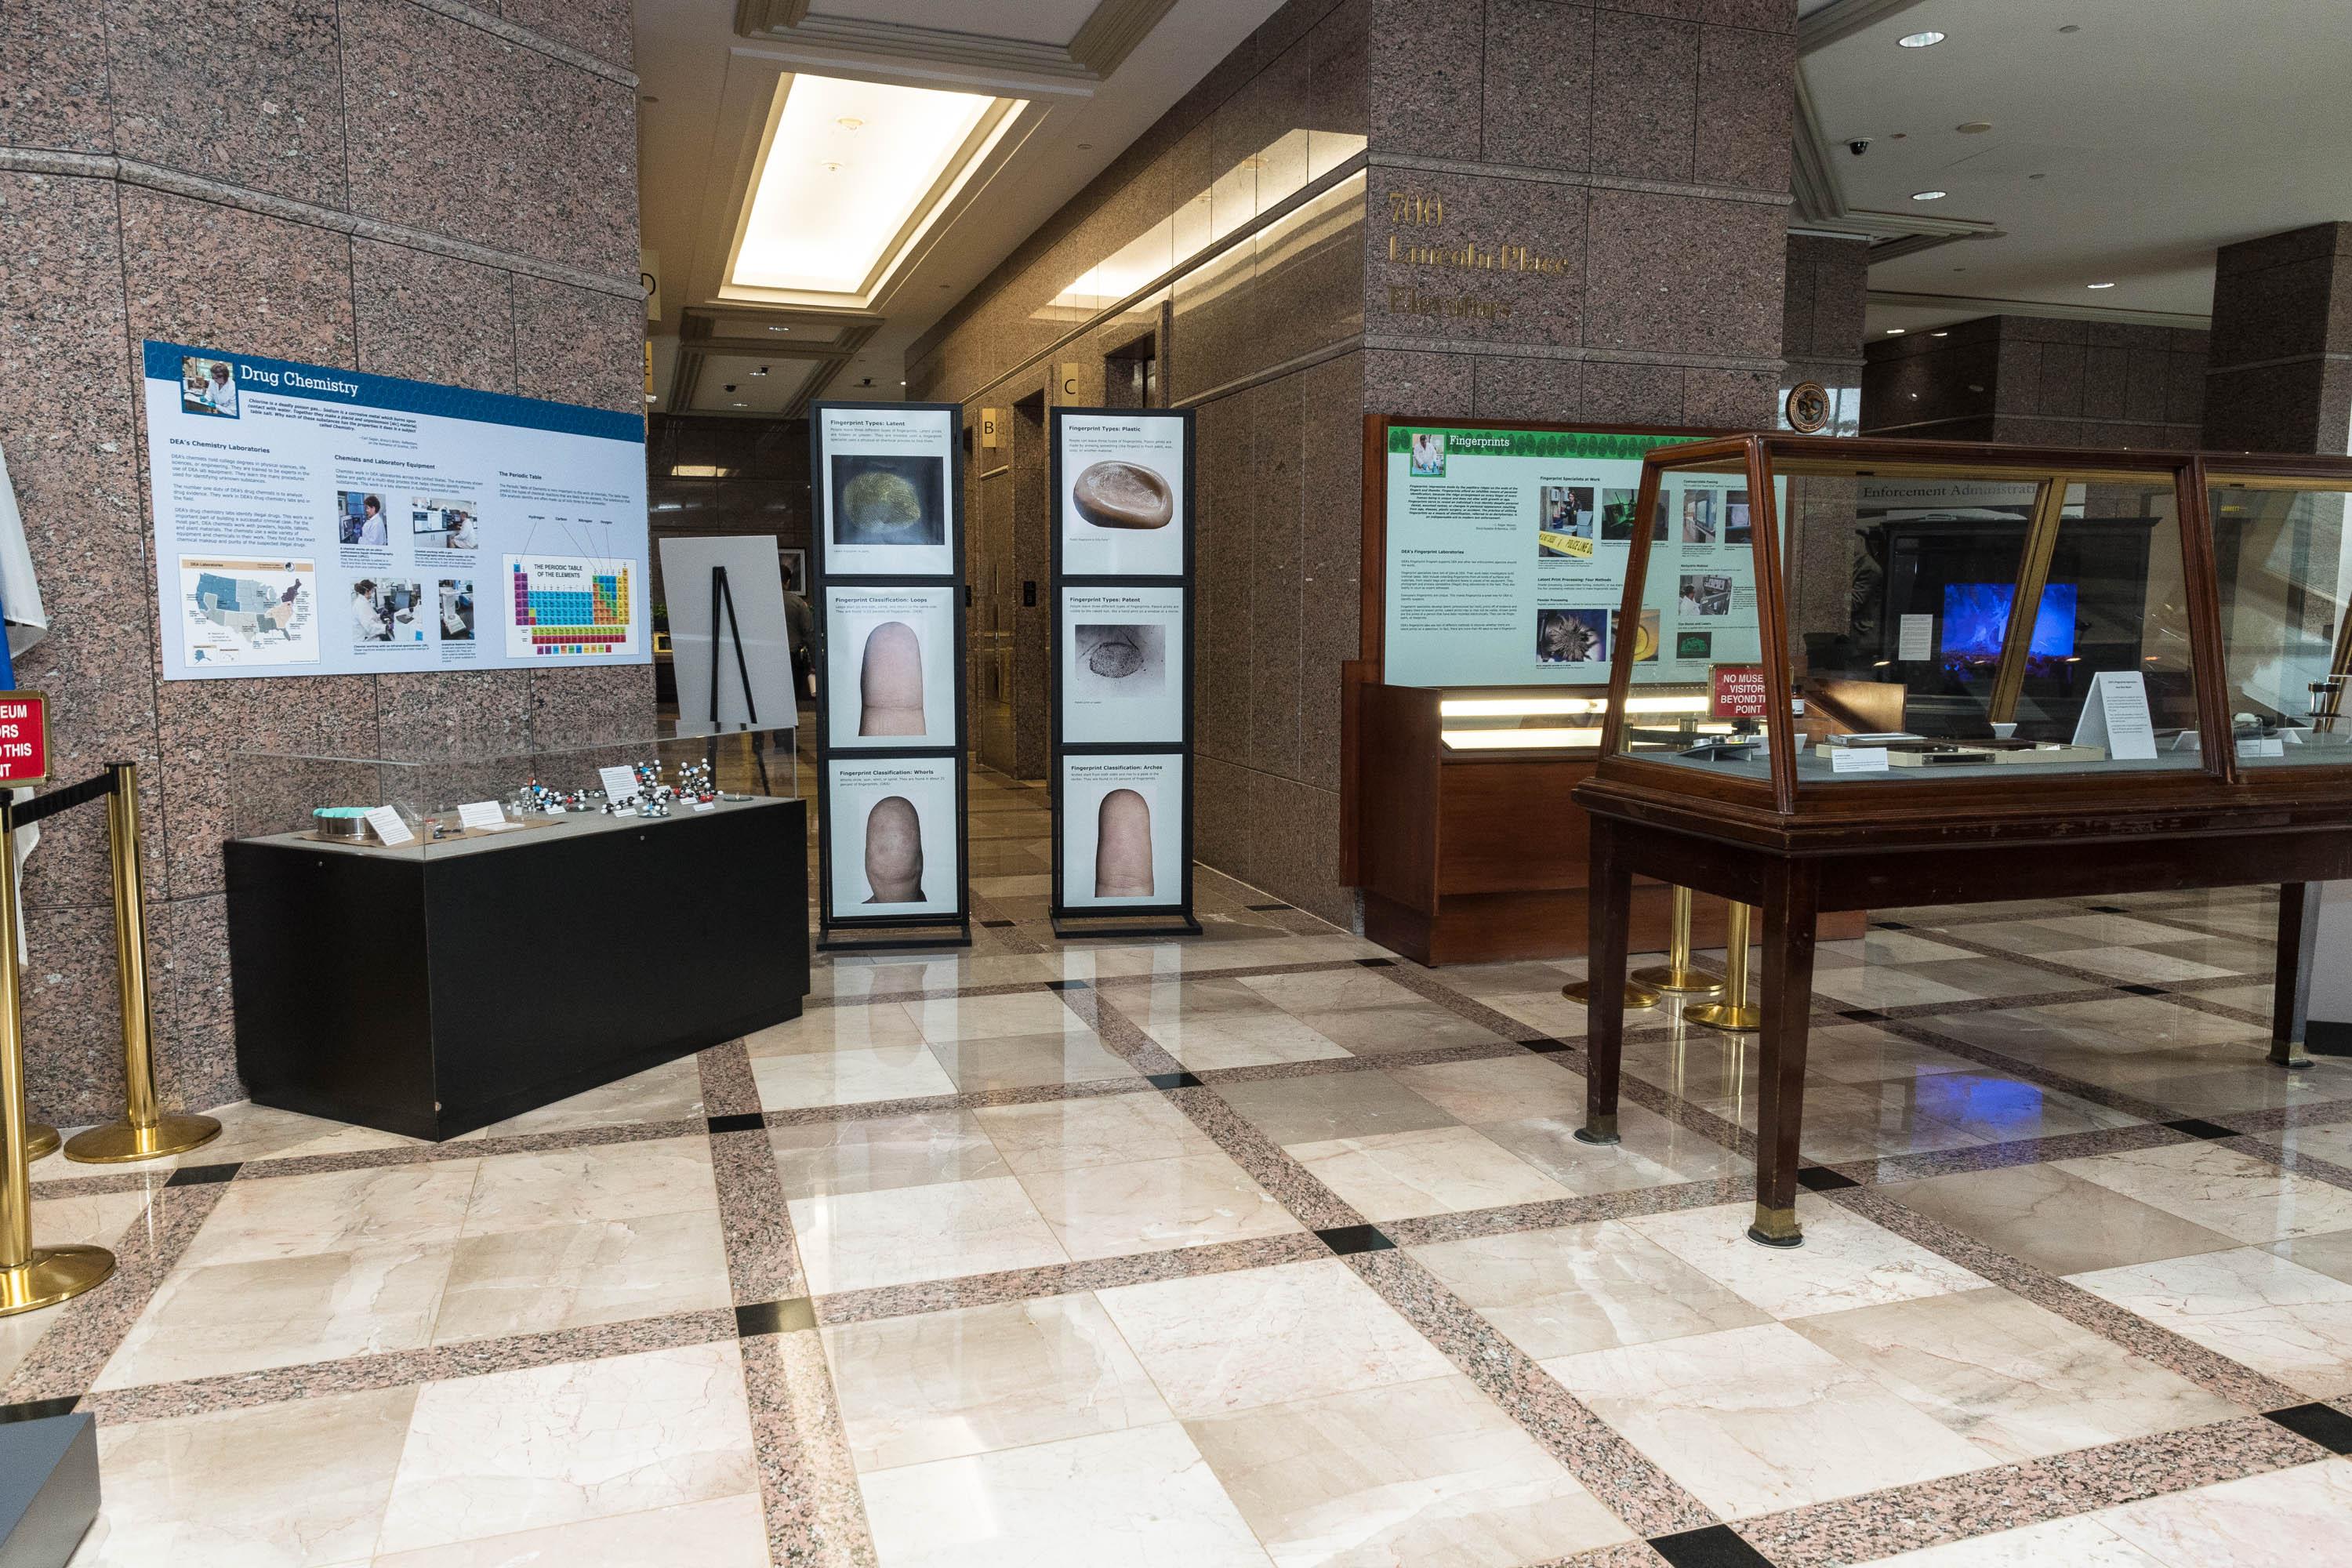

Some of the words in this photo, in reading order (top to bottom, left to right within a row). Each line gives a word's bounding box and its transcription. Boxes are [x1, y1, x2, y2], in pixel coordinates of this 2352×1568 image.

[1389, 192, 1443, 227] 700
[1390, 235, 1493, 270] Lincoln
[1388, 284, 1512, 318] Elevators
[240, 364, 279, 384] Drug
[285, 371, 358, 397] Chemistry
[1064, 379, 1076, 394] C
[985, 421, 993, 434] B
[191, 440, 227, 450] Chemistry
[228, 444, 269, 453] Laboratories
[1450, 435, 1510, 448] Fingerprints
[374, 459, 405, 467] Laboratory
[1863, 485, 1948, 497] Enforcement
[1952, 485, 2037, 496] Administrati
[1723, 674, 1736, 683] NO
[1739, 674, 1763, 683] MUSE
[1721, 695, 1757, 703] BEYOND
[1736, 705, 1762, 713] POINT
[0, 724, 19, 739] RS
[4, 743, 32, 757] THIS
